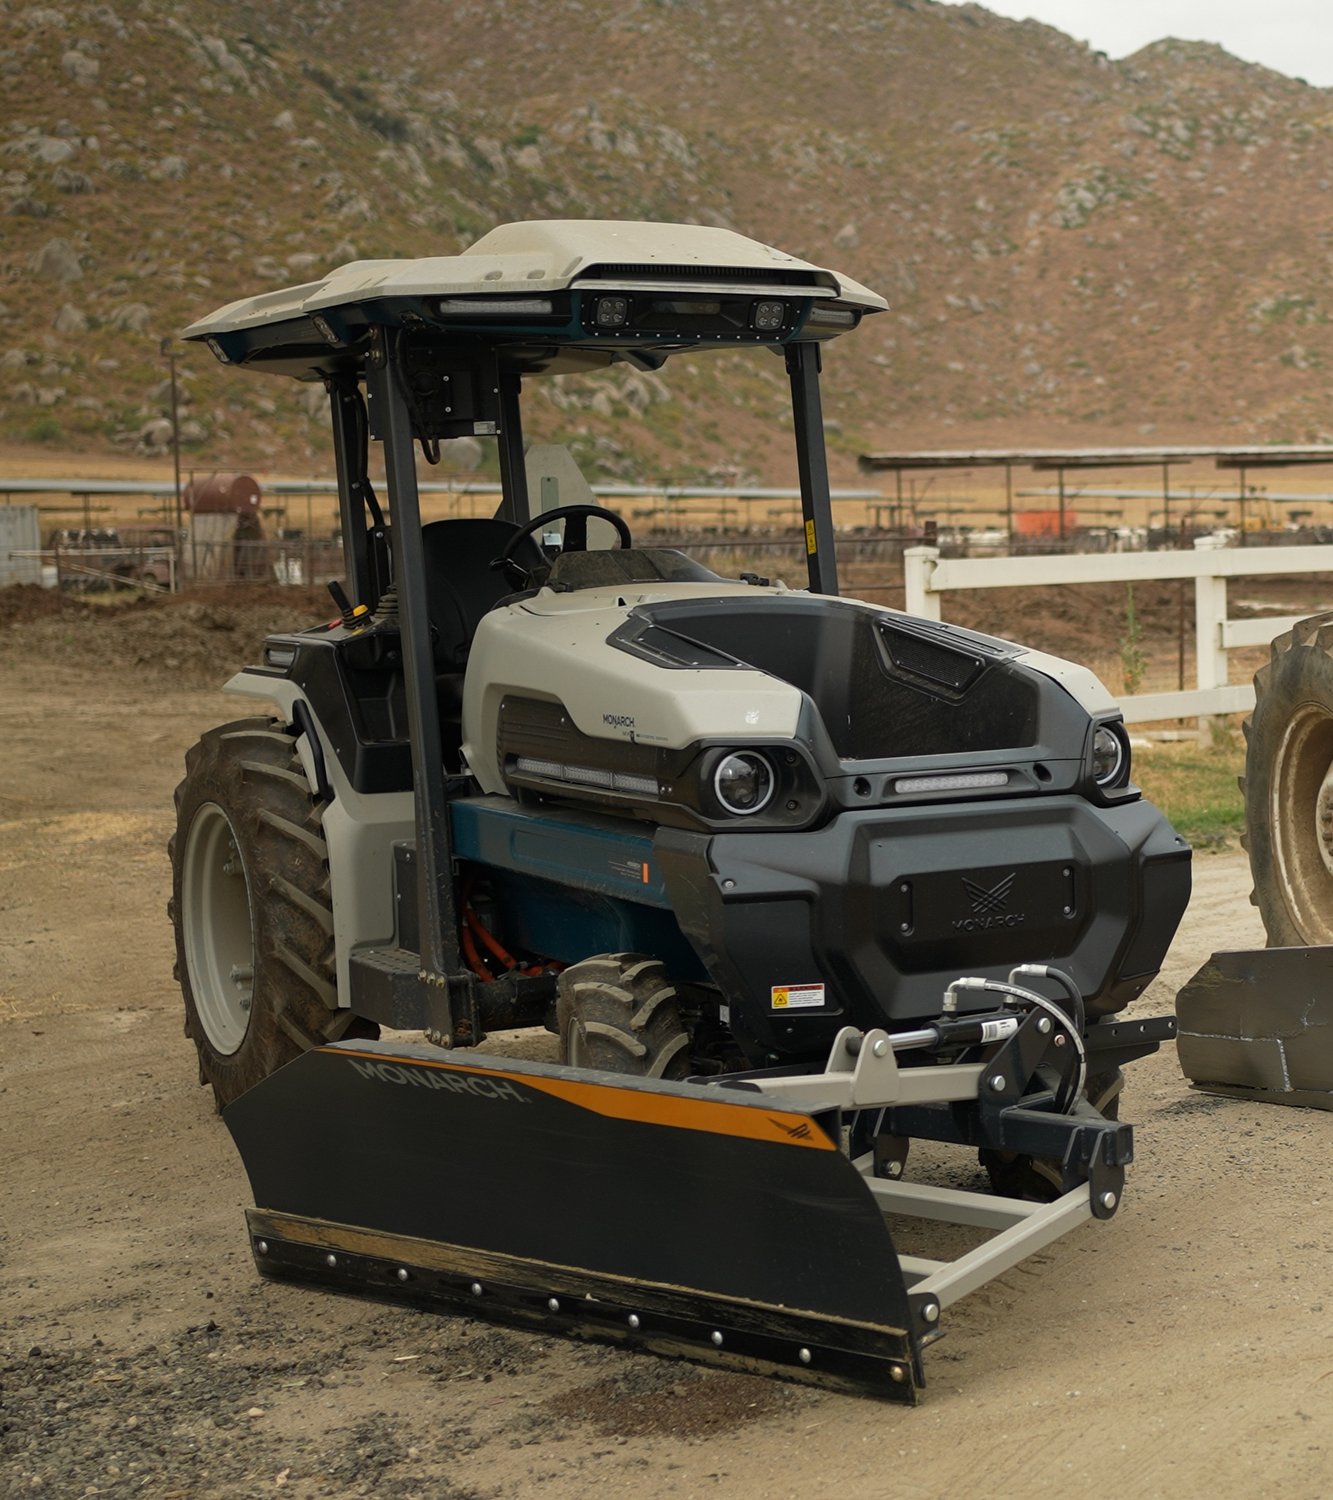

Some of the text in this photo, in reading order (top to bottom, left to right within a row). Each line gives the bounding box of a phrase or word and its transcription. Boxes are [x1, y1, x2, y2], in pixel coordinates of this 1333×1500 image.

[602, 713, 635, 728] MONARCH
[951, 913, 1026, 931] MONARCH
[347, 1058, 526, 1103] MONARCH
